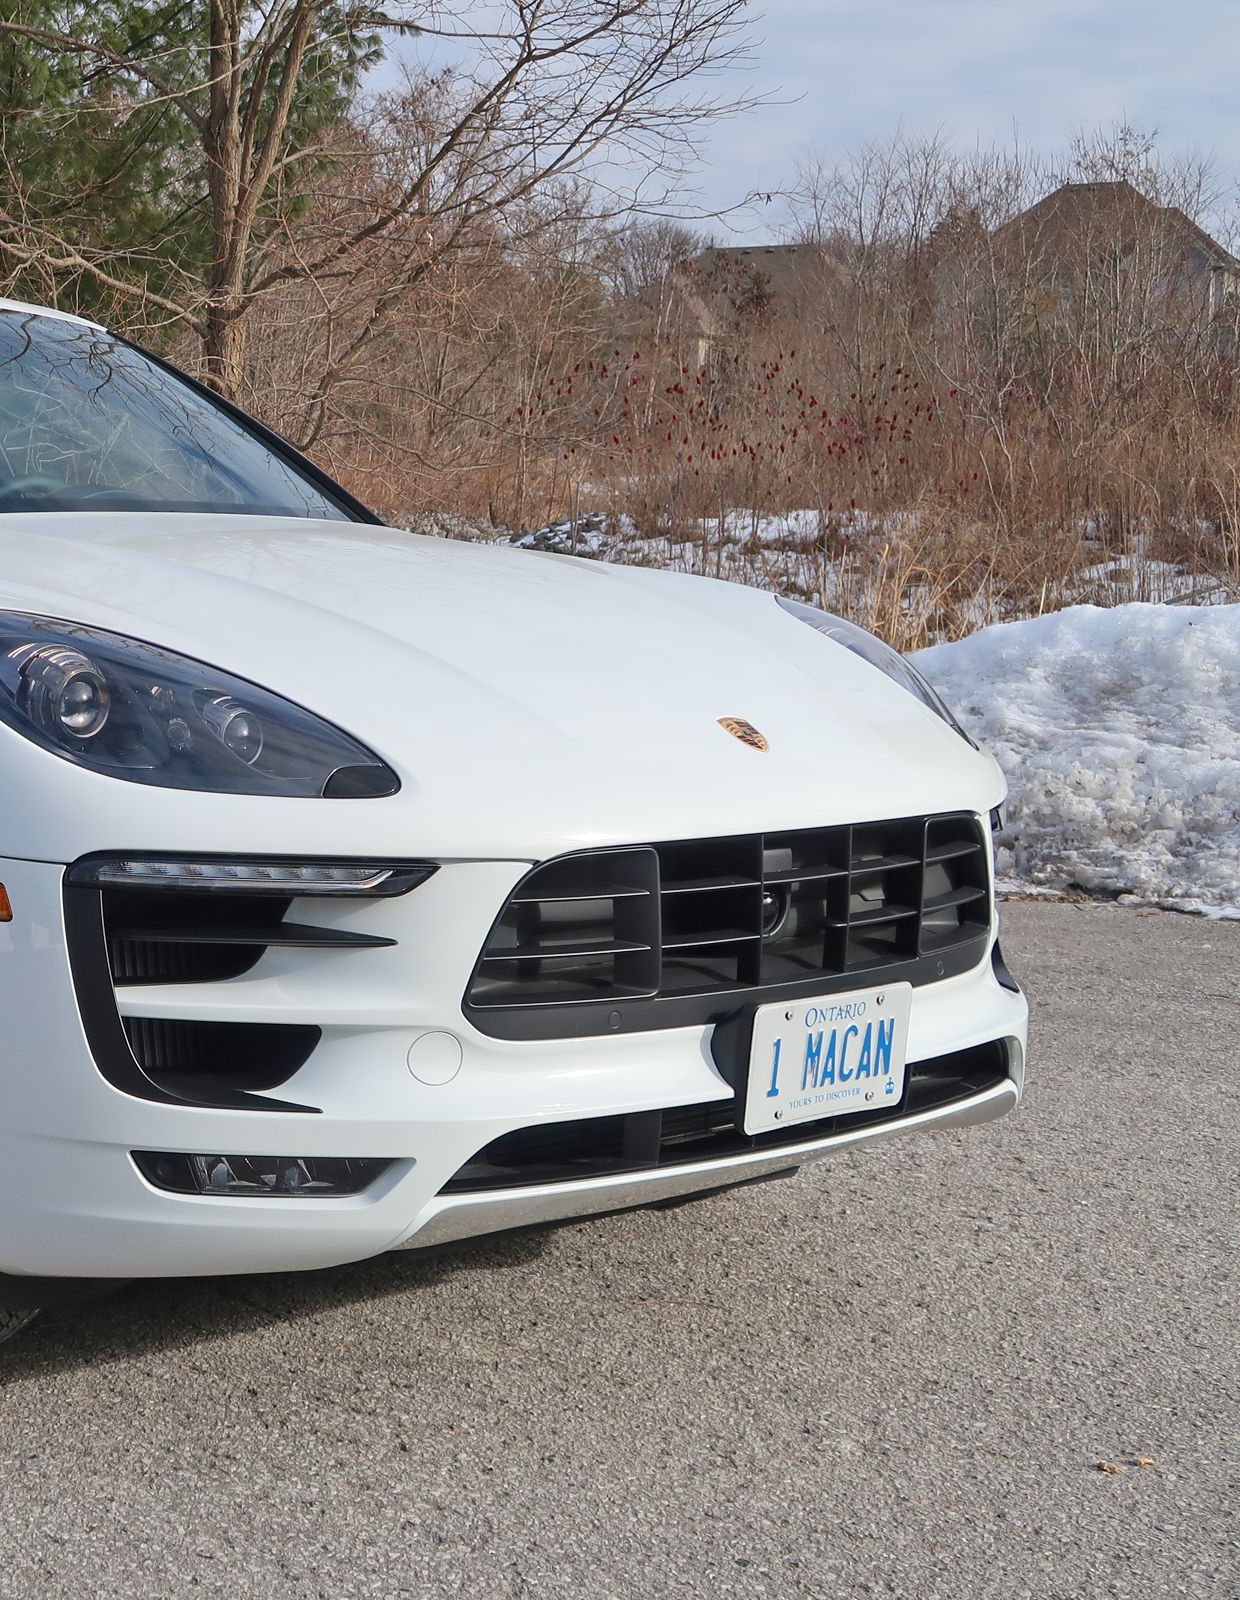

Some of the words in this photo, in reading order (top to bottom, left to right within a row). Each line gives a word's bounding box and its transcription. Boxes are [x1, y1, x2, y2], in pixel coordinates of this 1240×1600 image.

[805, 1001, 867, 1028] ONTARIO
[766, 1038, 781, 1098] 1
[801, 1017, 895, 1091] MACAN
[789, 1096, 812, 1109] YOURS
[814, 1094, 825, 1104] TO
[826, 1087, 861, 1101] DISCOVER
